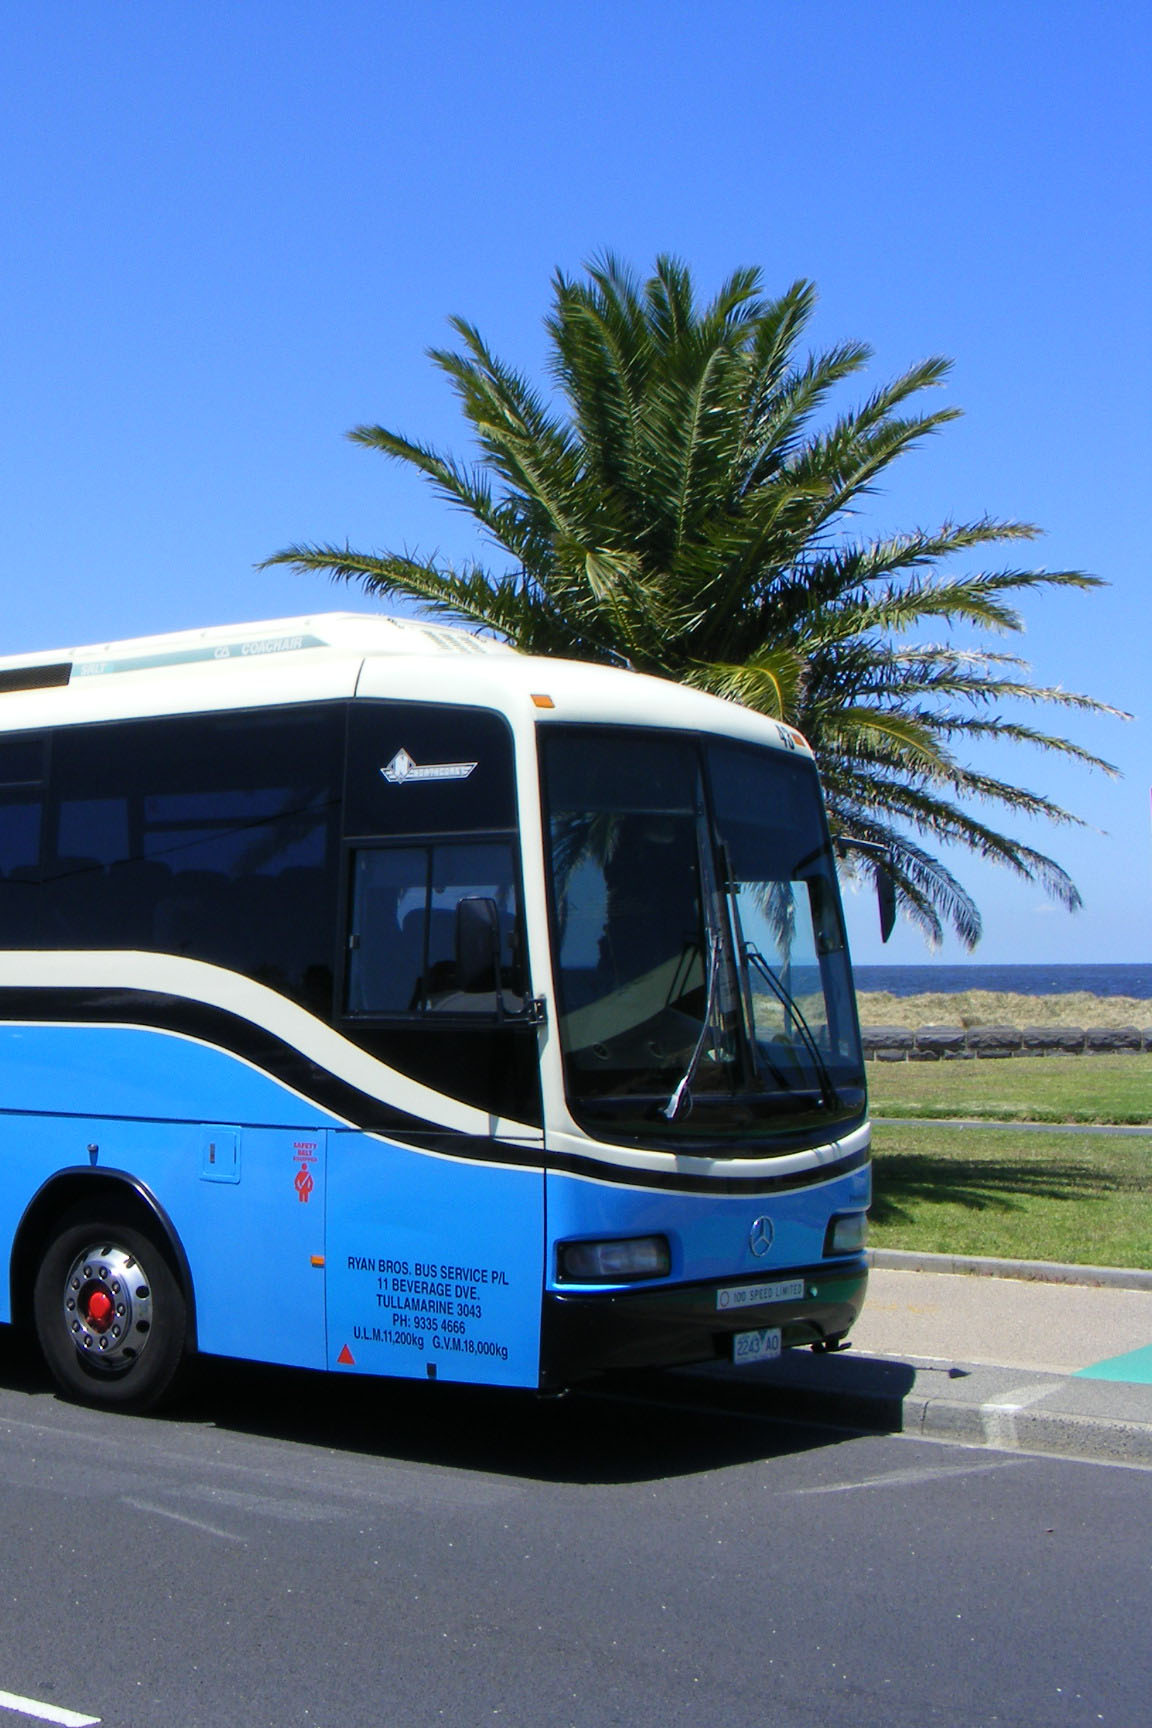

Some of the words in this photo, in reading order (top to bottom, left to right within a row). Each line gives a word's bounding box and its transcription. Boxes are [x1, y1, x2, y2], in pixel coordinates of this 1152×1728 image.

[347, 1256, 376, 1271] RYAN
[378, 1259, 412, 1276] BROS.
[414, 1262, 438, 1277] BUS
[440, 1265, 488, 1283] SERVICE
[491, 1270, 509, 1285] P/L
[378, 1277, 388, 1290] 11
[392, 1278, 454, 1297] BEVERAGE
[455, 1284, 480, 1300] DVE.
[750, 1287, 772, 1301] SPEED
[775, 1283, 802, 1297] LIMITED
[376, 1294, 454, 1315] TULLAMARINE
[457, 1303, 482, 1318] 3043
[392, 1313, 411, 1328] PH:
[413, 1316, 438, 1331] 9335
[440, 1319, 466, 1334] 4666
